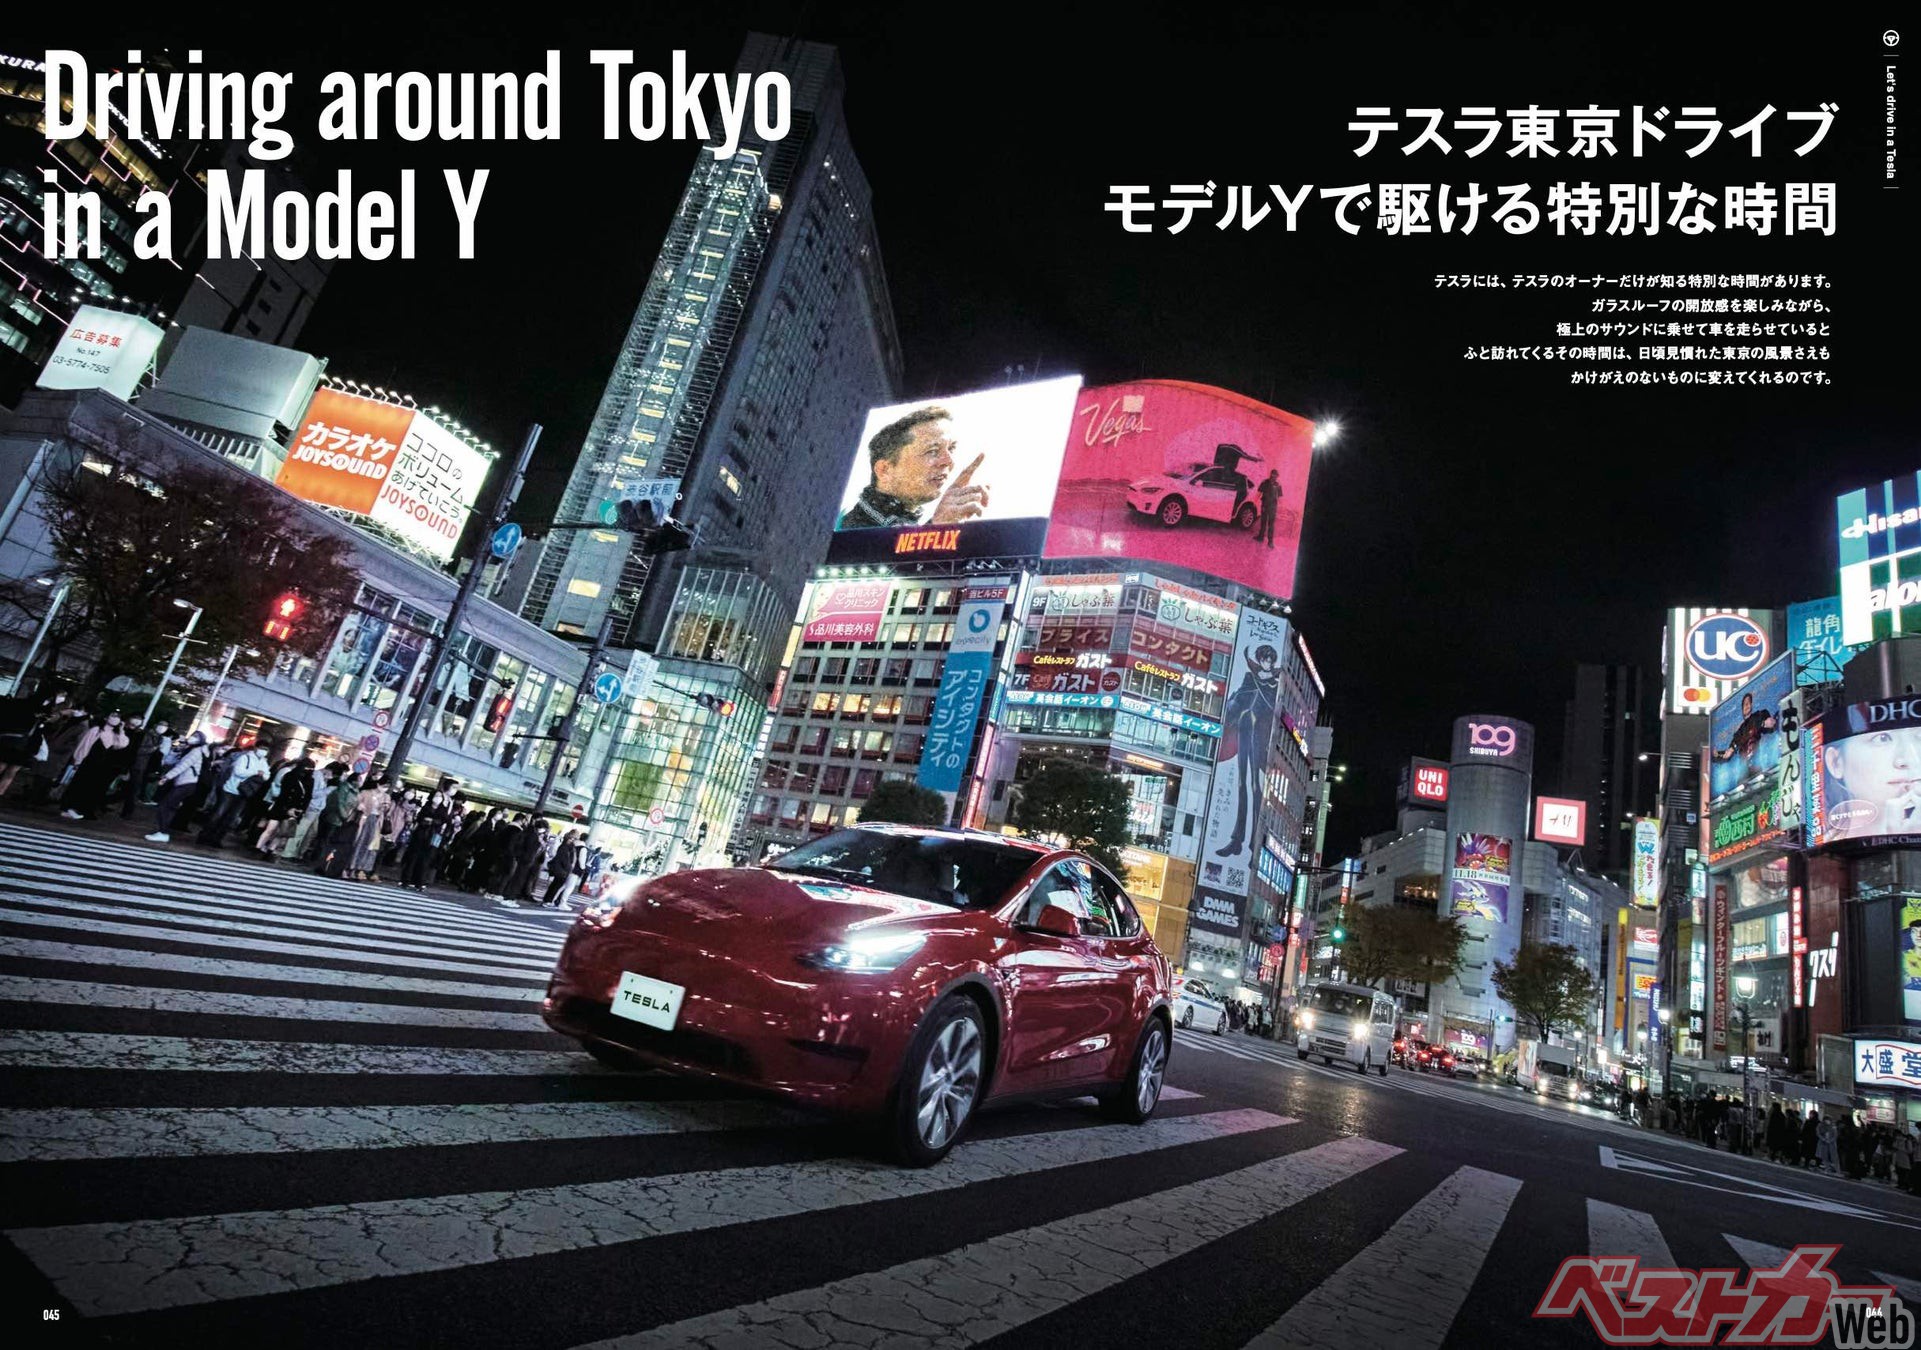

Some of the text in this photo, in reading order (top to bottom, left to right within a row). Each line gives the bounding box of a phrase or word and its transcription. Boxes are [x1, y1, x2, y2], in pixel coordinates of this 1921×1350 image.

[69, 328, 122, 348] 広告募集
[1080, 398, 1152, 447] Vegas
[301, 421, 397, 461] カラオケ
[292, 444, 388, 480] JOYSOUND
[405, 432, 463, 480] ココロの
[381, 484, 459, 540] JOYSOUND
[894, 529, 961, 554] NETFLIX
[1032, 596, 1047, 607] 9F
[813, 623, 875, 636] 品川美容外科
[1131, 630, 1209, 665] コンタクト
[1075, 653, 1113, 669] ガスト
[1014, 673, 1031, 685] 7F
[1051, 672, 1096, 692] ガスト
[1181, 672, 1219, 694] ガスト
[930, 669, 968, 768] アイシティ
[946, 669, 983, 769] コンタクトの
[1869, 699, 1921, 724] DHC
[1468, 723, 1516, 756] 109
[1469, 746, 1499, 757] SHIBUYA
[1419, 768, 1443, 783] UNI
[1418, 782, 1444, 797] QLO
[1203, 895, 1236, 914] DMM
[1196, 907, 1239, 928] GAMES
[624, 990, 670, 1013] TESLA
[1862, 1048, 1921, 1078] 大盛堂
